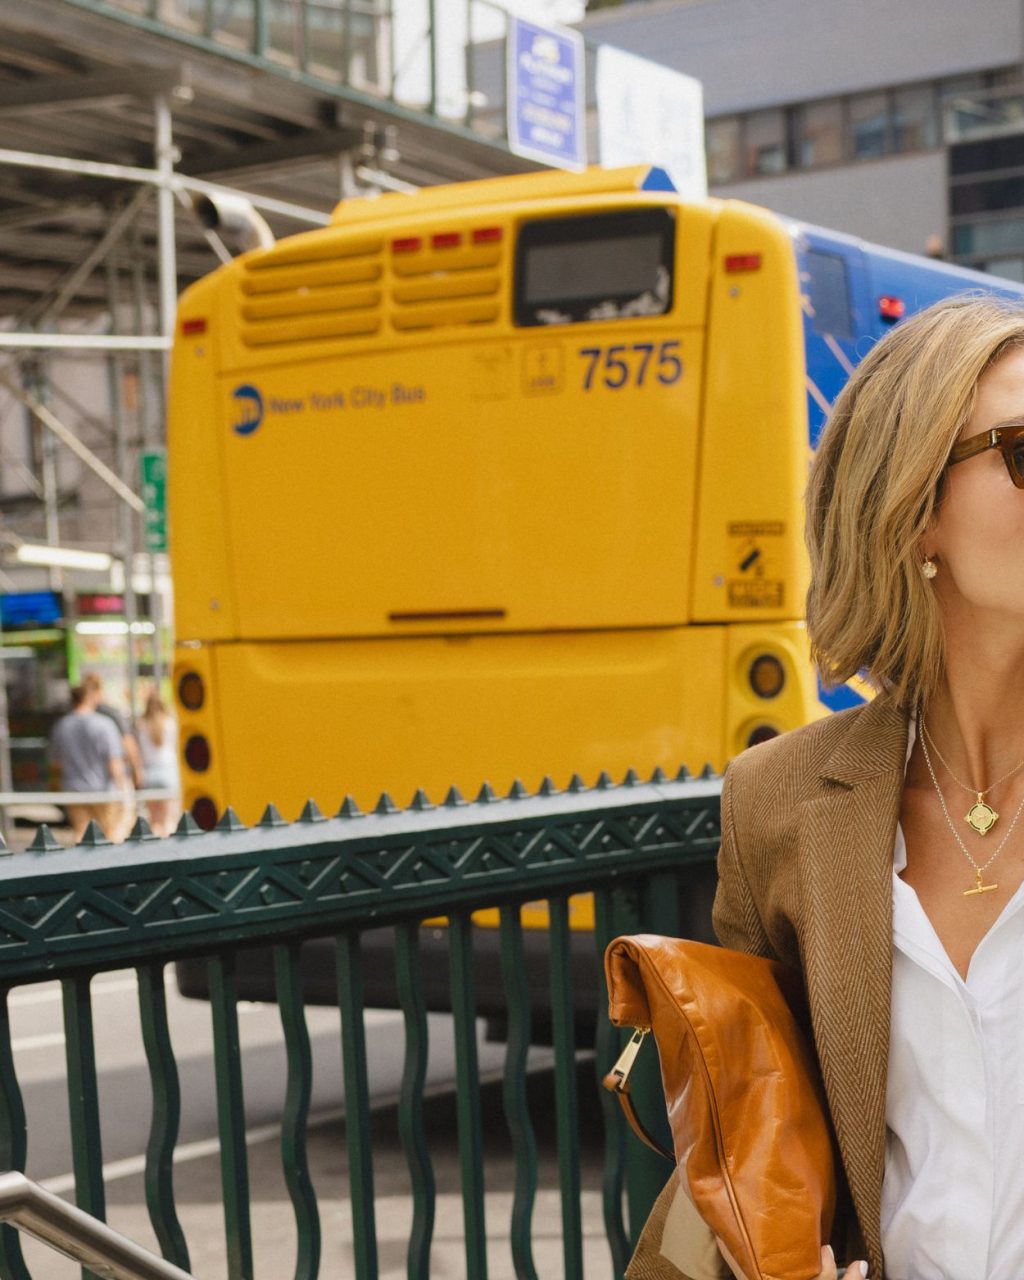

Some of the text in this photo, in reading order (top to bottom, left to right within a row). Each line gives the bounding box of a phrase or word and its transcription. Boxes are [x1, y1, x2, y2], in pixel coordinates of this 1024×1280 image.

[579, 340, 683, 391] 7575
[270, 383, 426, 414] New York City Bus
